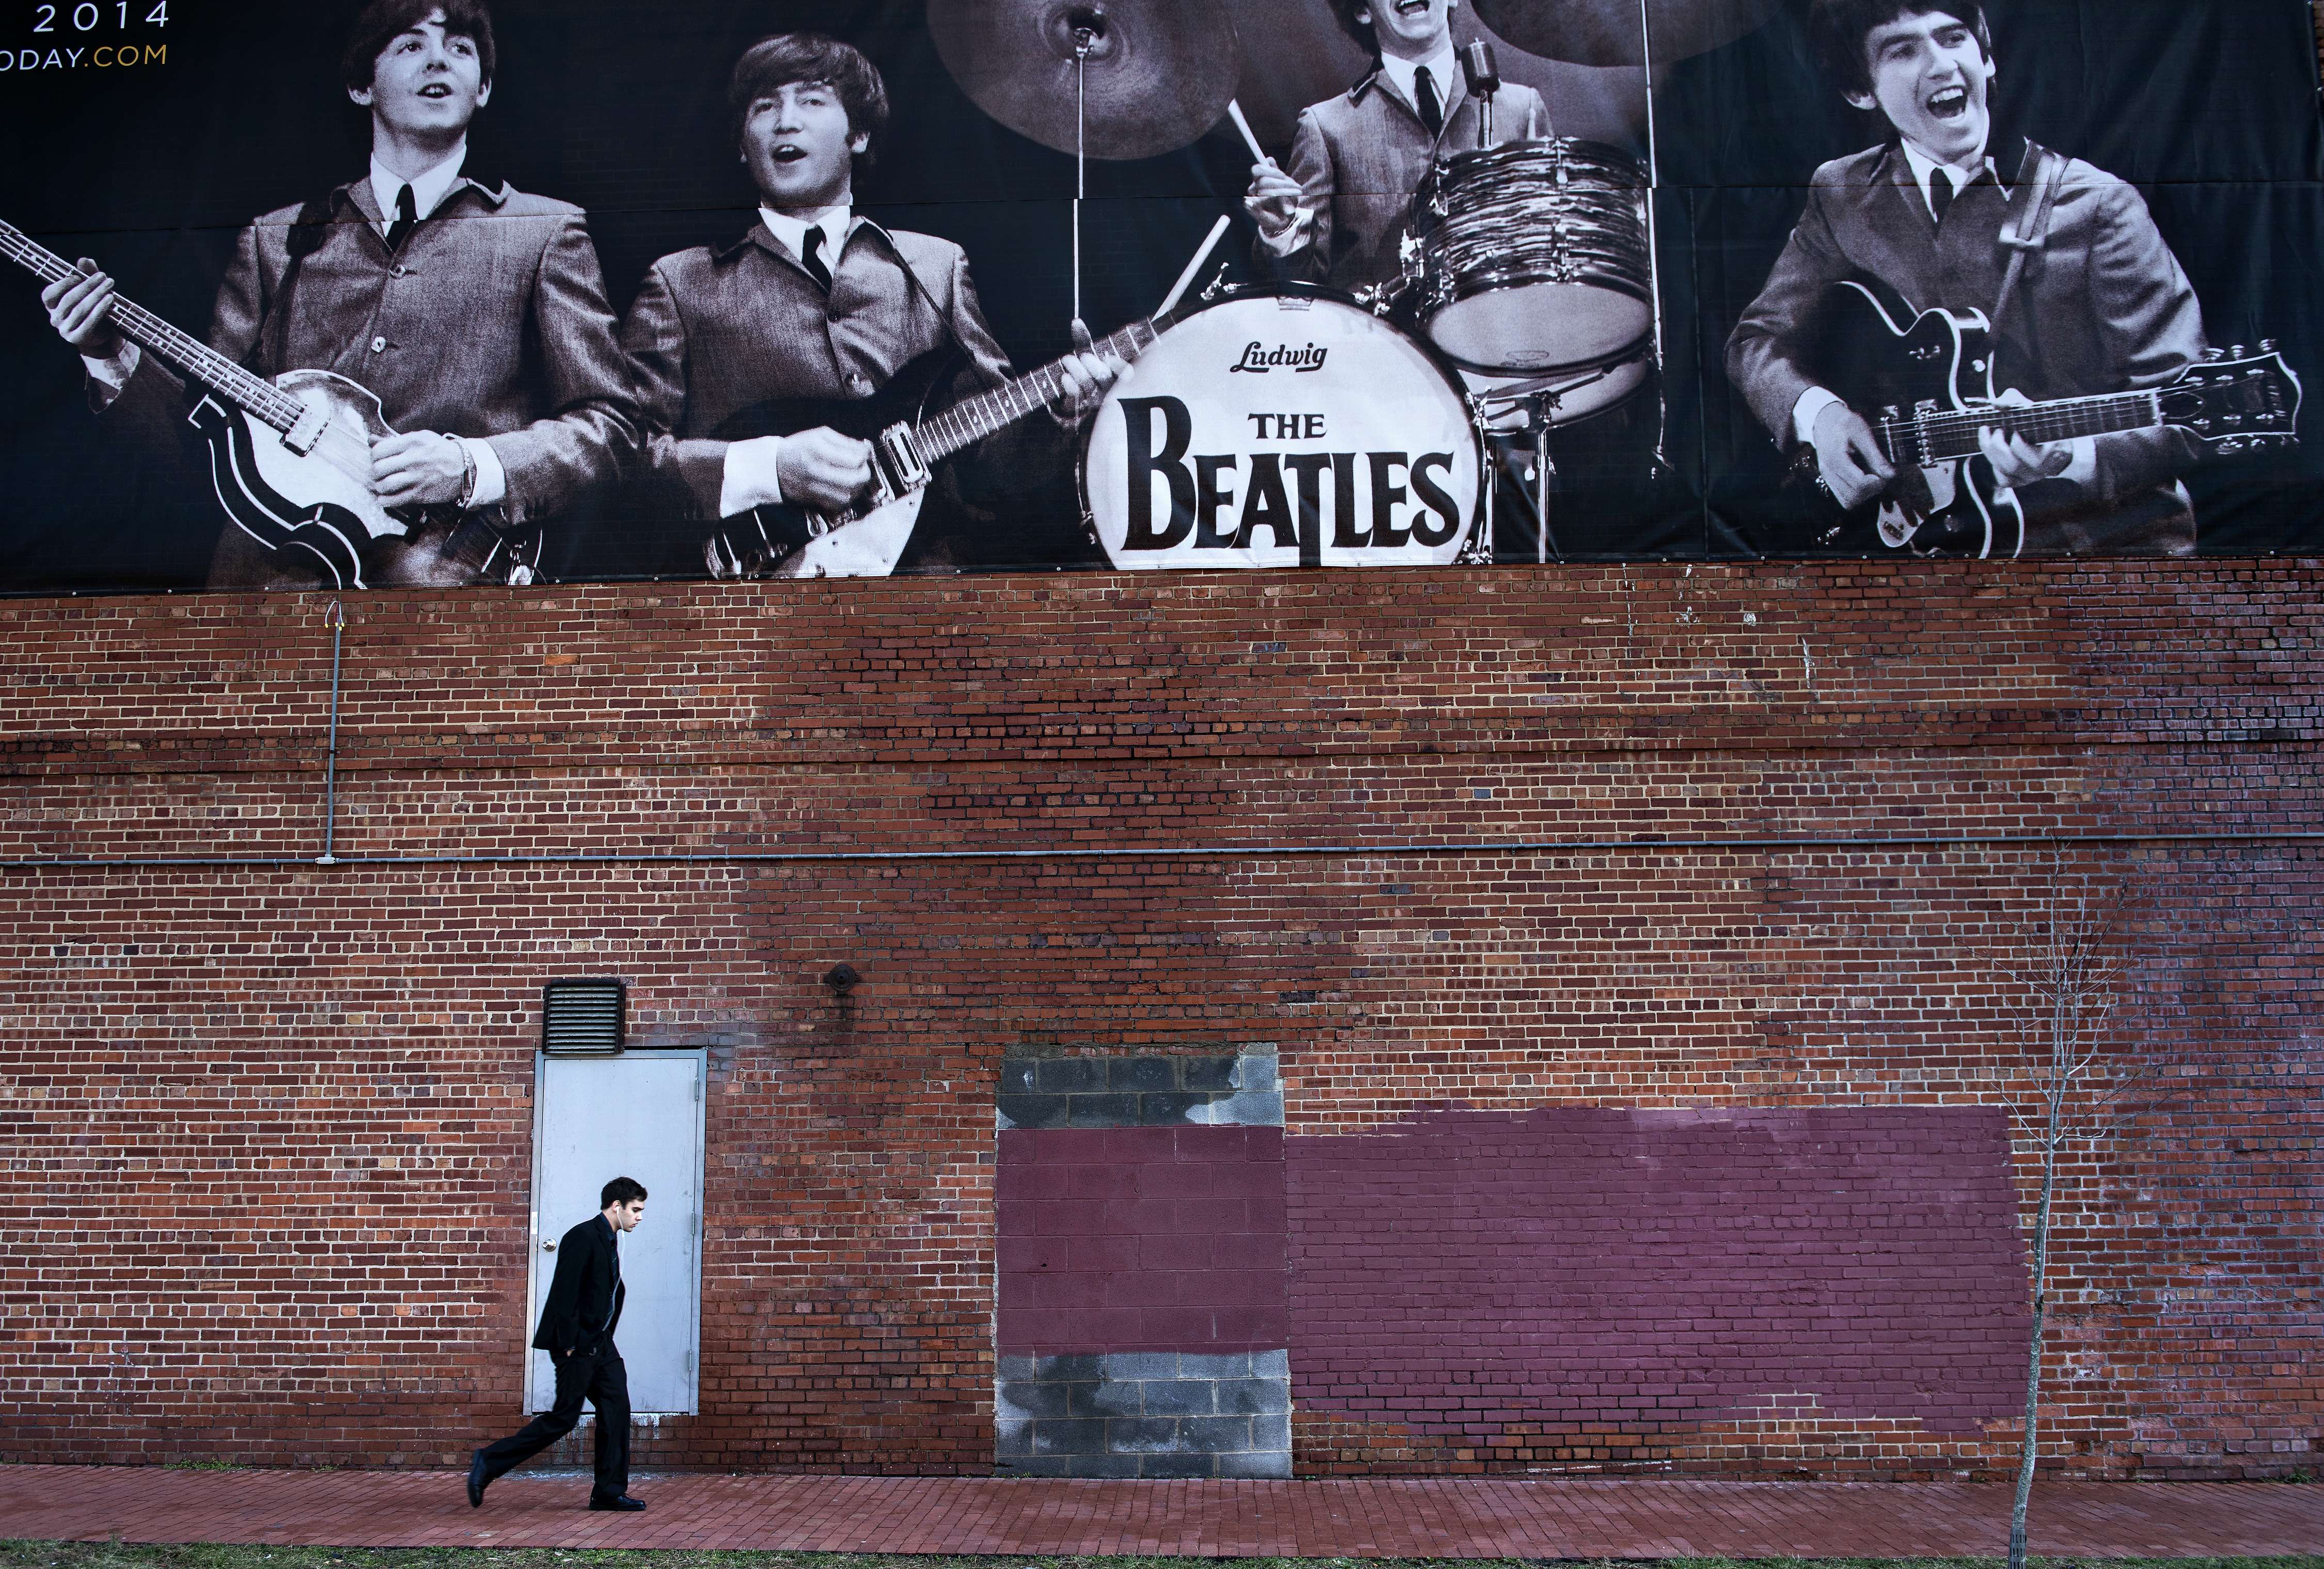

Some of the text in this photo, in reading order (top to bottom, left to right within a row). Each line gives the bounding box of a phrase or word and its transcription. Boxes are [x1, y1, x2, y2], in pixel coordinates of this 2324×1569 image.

[34, 1, 169, 32] 2014
[1230, 341, 1328, 373] Ludwig
[1248, 414, 1326, 439] THE
[1117, 395, 1460, 566] BEATLES
